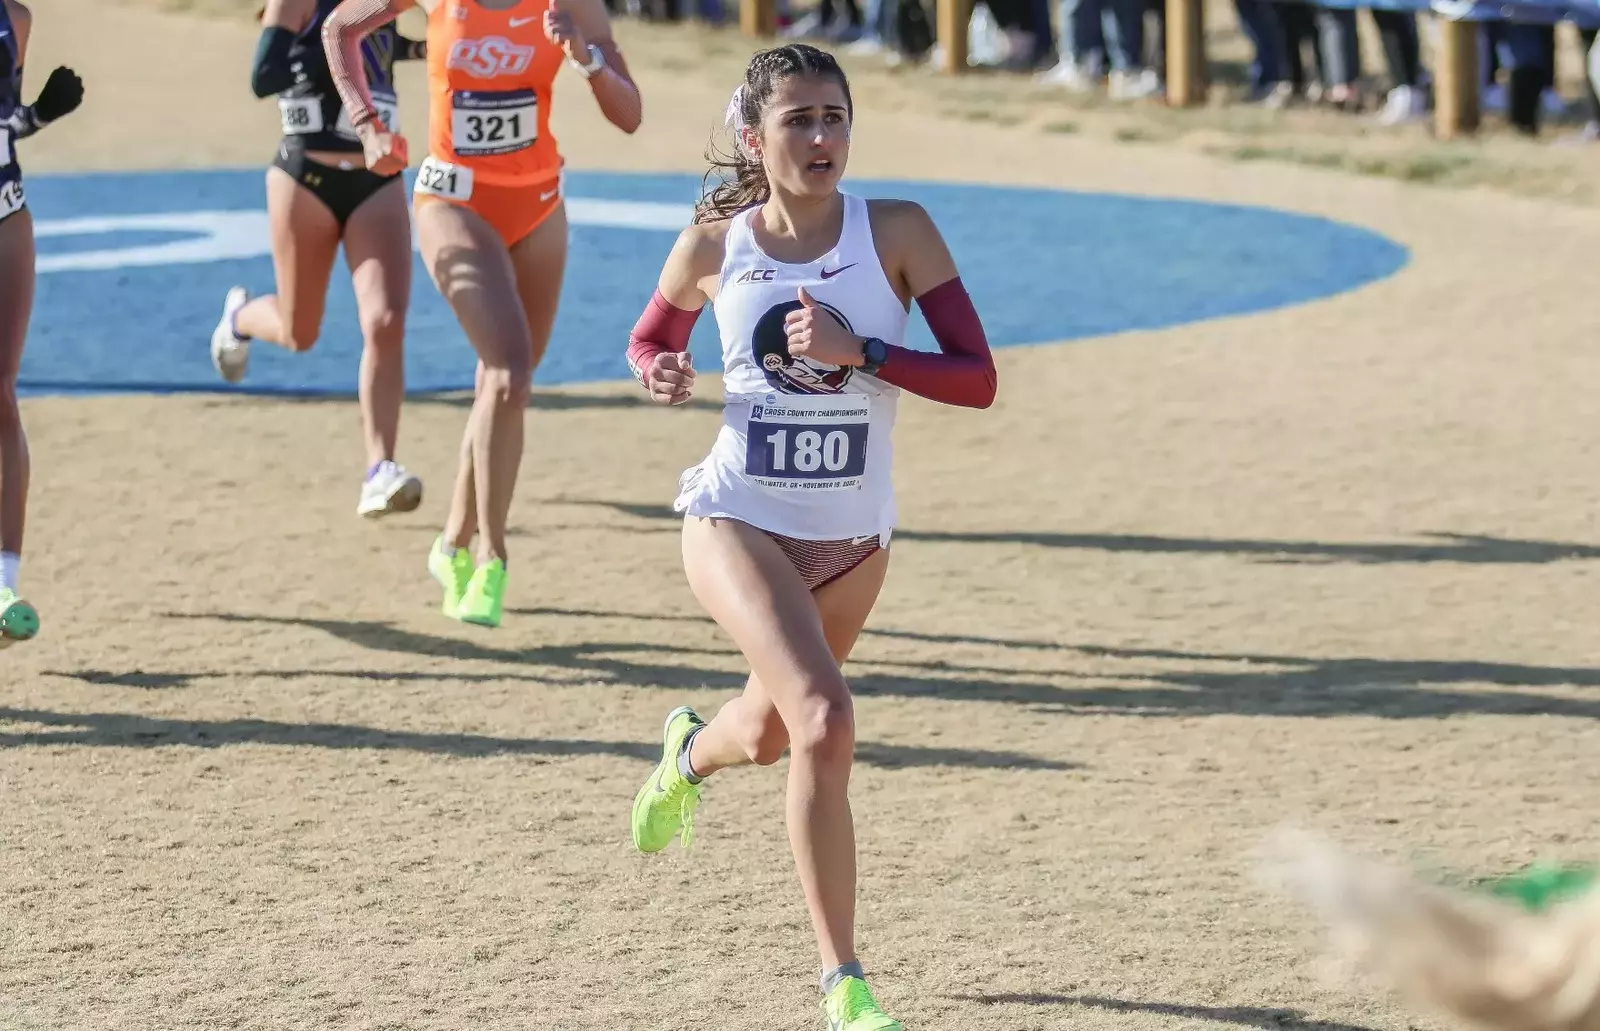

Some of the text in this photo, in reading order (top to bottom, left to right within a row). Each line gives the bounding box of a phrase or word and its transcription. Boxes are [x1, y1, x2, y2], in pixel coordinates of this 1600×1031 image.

[466, 113, 521, 143] 321
[420, 165, 458, 193] 321
[736, 269, 777, 284] ACC
[764, 408, 868, 418] CROSS COUNTRY CHAMPIONSHIPS
[767, 429, 850, 473] 180
